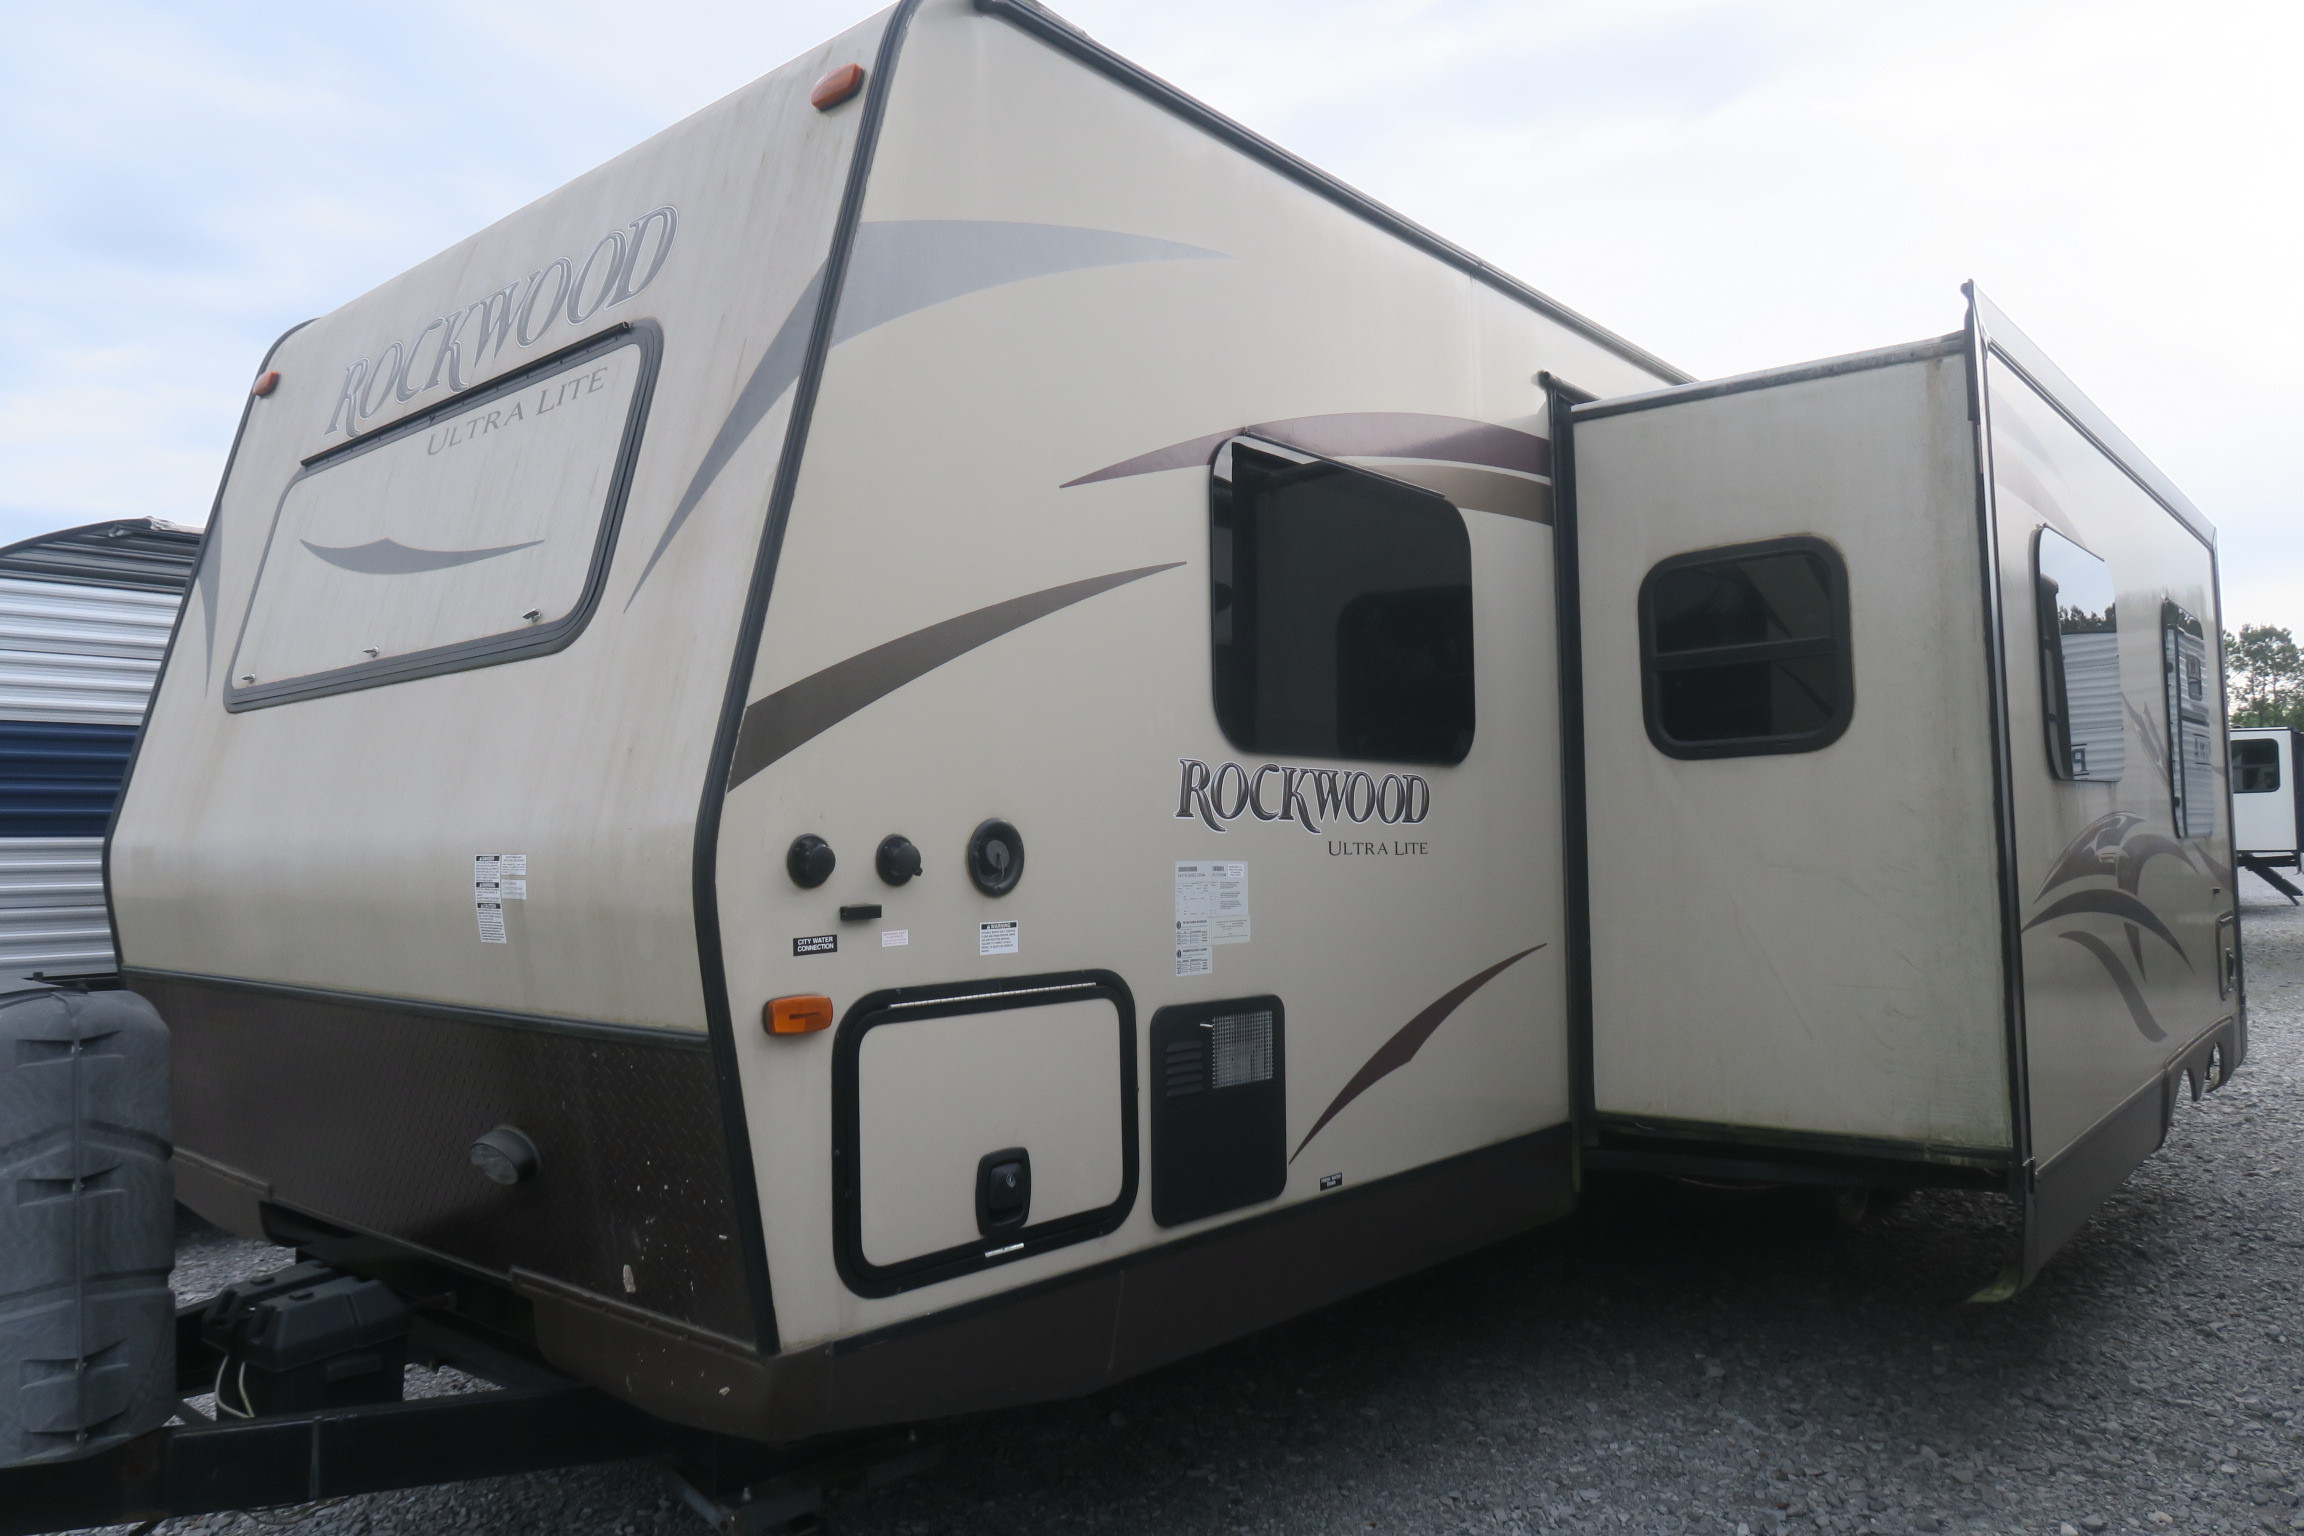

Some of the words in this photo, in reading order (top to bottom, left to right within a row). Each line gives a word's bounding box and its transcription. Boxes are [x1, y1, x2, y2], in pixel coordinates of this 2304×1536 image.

[323, 205, 679, 439] ROCKWOOD
[427, 400, 524, 456] ULTRA
[536, 366, 608, 416] LITE
[1173, 757, 1431, 834] ROCKWOOD
[1328, 840, 1388, 856] ULTRA
[1394, 841, 1429, 856] LITE
[797, 938, 811, 946] CITY
[812, 936, 833, 944] WATER
[797, 943, 834, 952] CONNECTION
